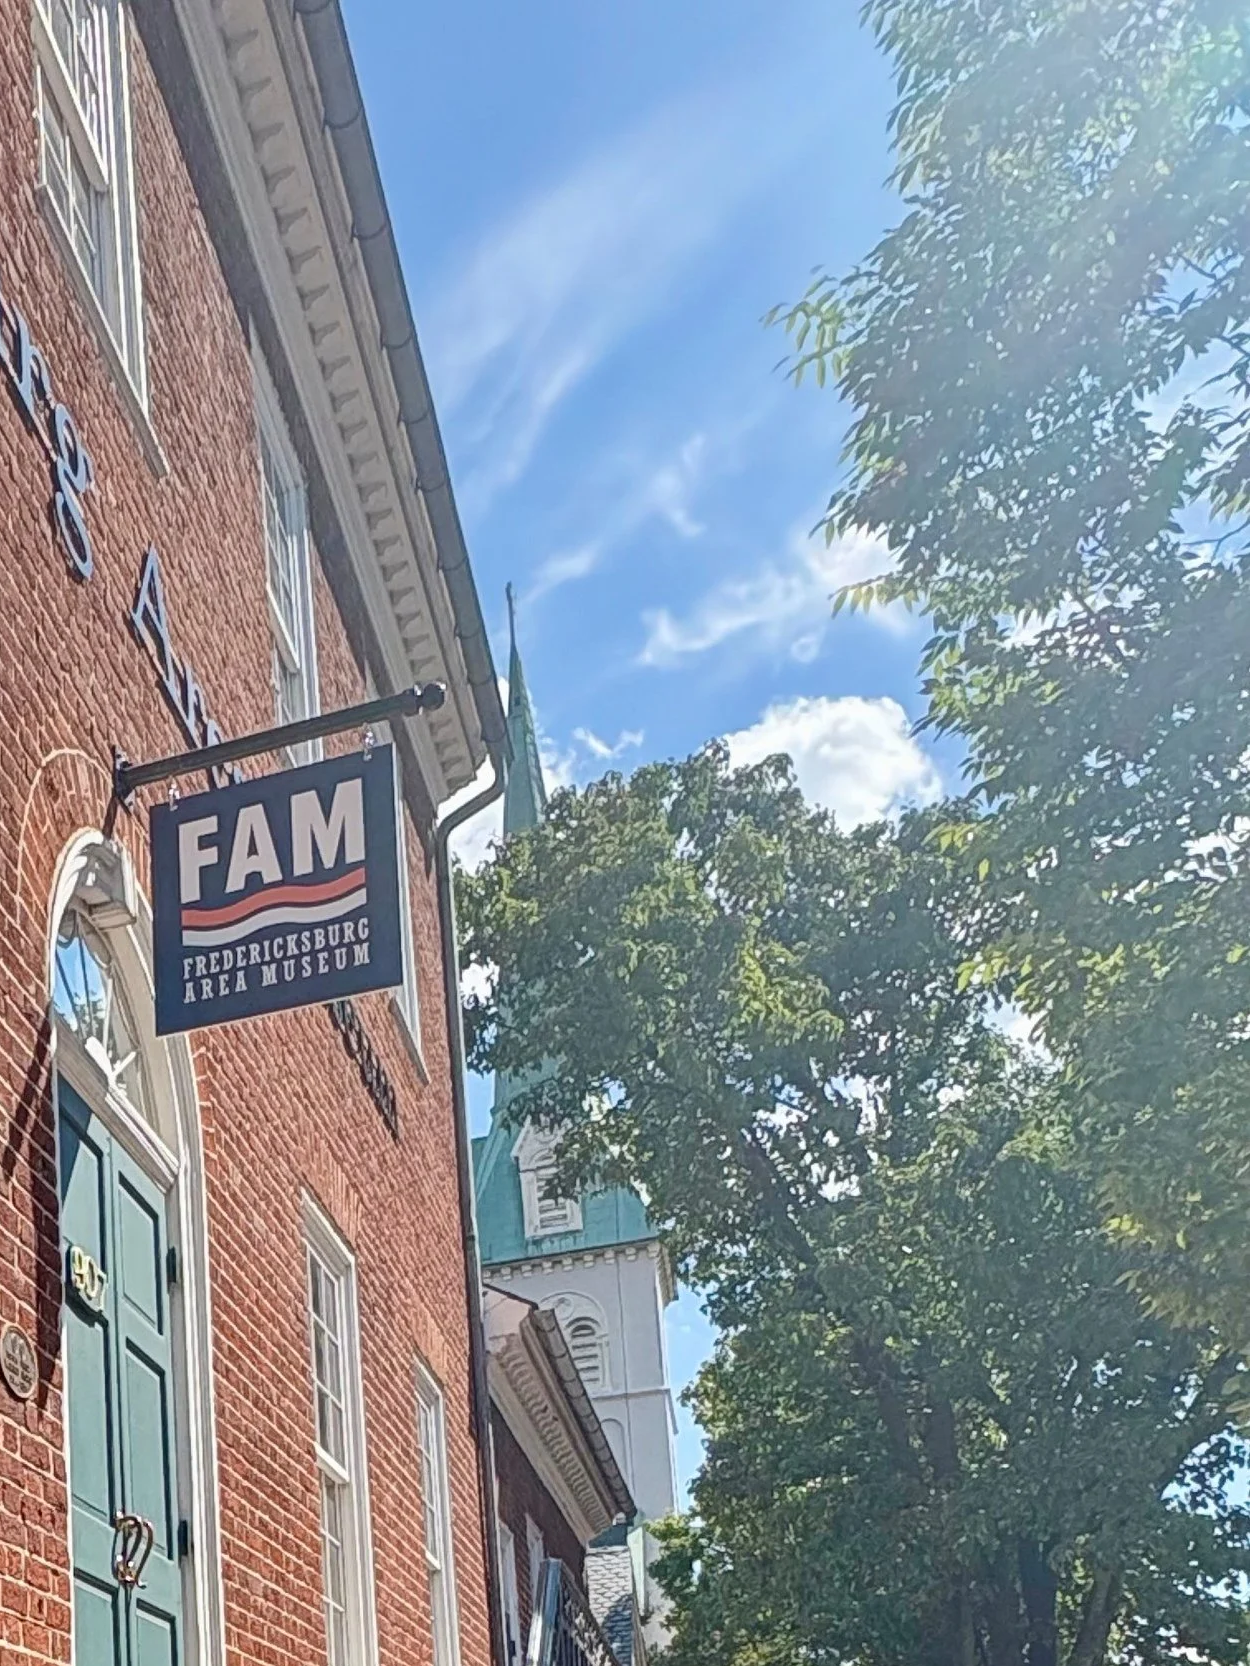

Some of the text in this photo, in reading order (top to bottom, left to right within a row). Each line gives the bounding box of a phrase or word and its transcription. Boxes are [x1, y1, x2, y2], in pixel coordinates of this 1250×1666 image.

[178, 778, 365, 904] FAM
[182, 918, 370, 979] FREDERICKSBURG
[183, 951, 371, 1004] AREA MUSEUM
[71, 1246, 107, 1311] 907
